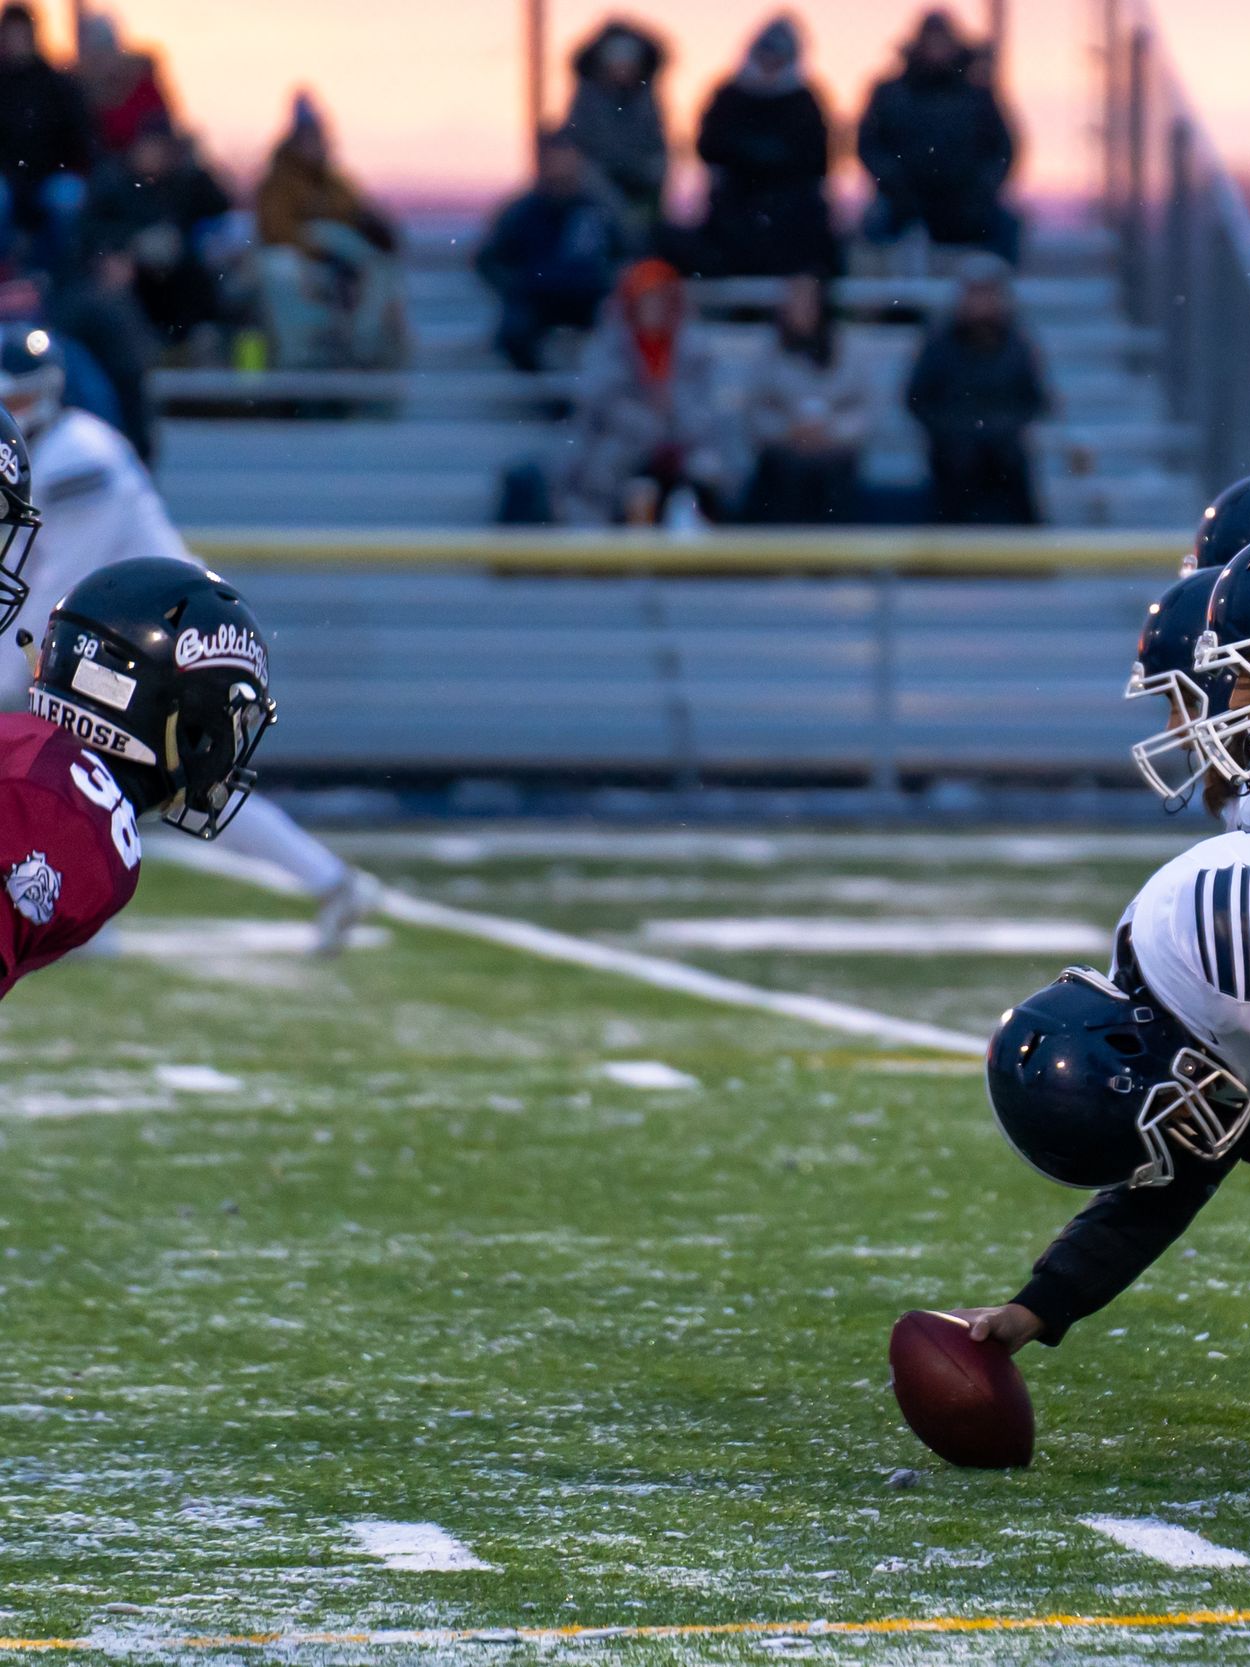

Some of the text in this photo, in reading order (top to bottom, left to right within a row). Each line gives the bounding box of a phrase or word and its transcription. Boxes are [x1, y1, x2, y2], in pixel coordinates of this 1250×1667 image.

[73, 634, 99, 659] 38
[175, 623, 268, 688] Bulldogs
[69, 748, 142, 871] 38
